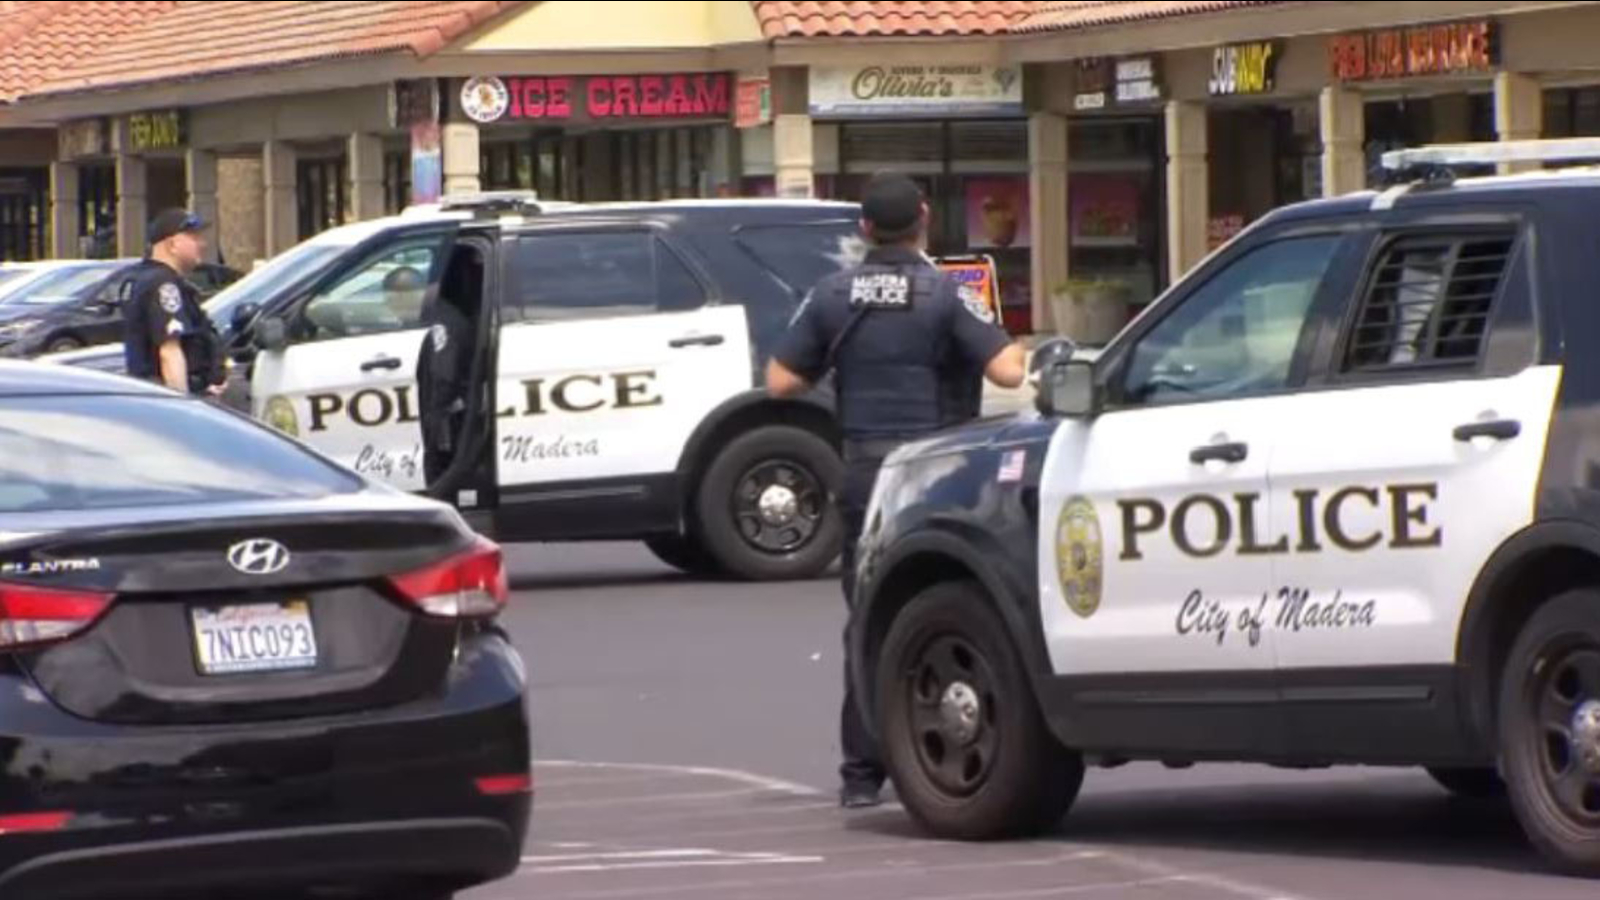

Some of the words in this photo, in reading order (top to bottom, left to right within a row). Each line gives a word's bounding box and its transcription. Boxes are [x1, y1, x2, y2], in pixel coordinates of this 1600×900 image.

[1209, 43, 1272, 95] SUBWAY
[509, 77, 572, 117] ICE
[586, 73, 727, 116] CREAM
[850, 289, 907, 304] POLICE
[354, 444, 395, 476] City
[400, 443, 420, 477] of
[502, 434, 600, 463] Madera
[1116, 482, 1443, 561] POLICE
[1176, 589, 1229, 646] City
[1237, 592, 1268, 647] of
[1275, 586, 1376, 632] Madera
[202, 623, 312, 660] 7NIC093
